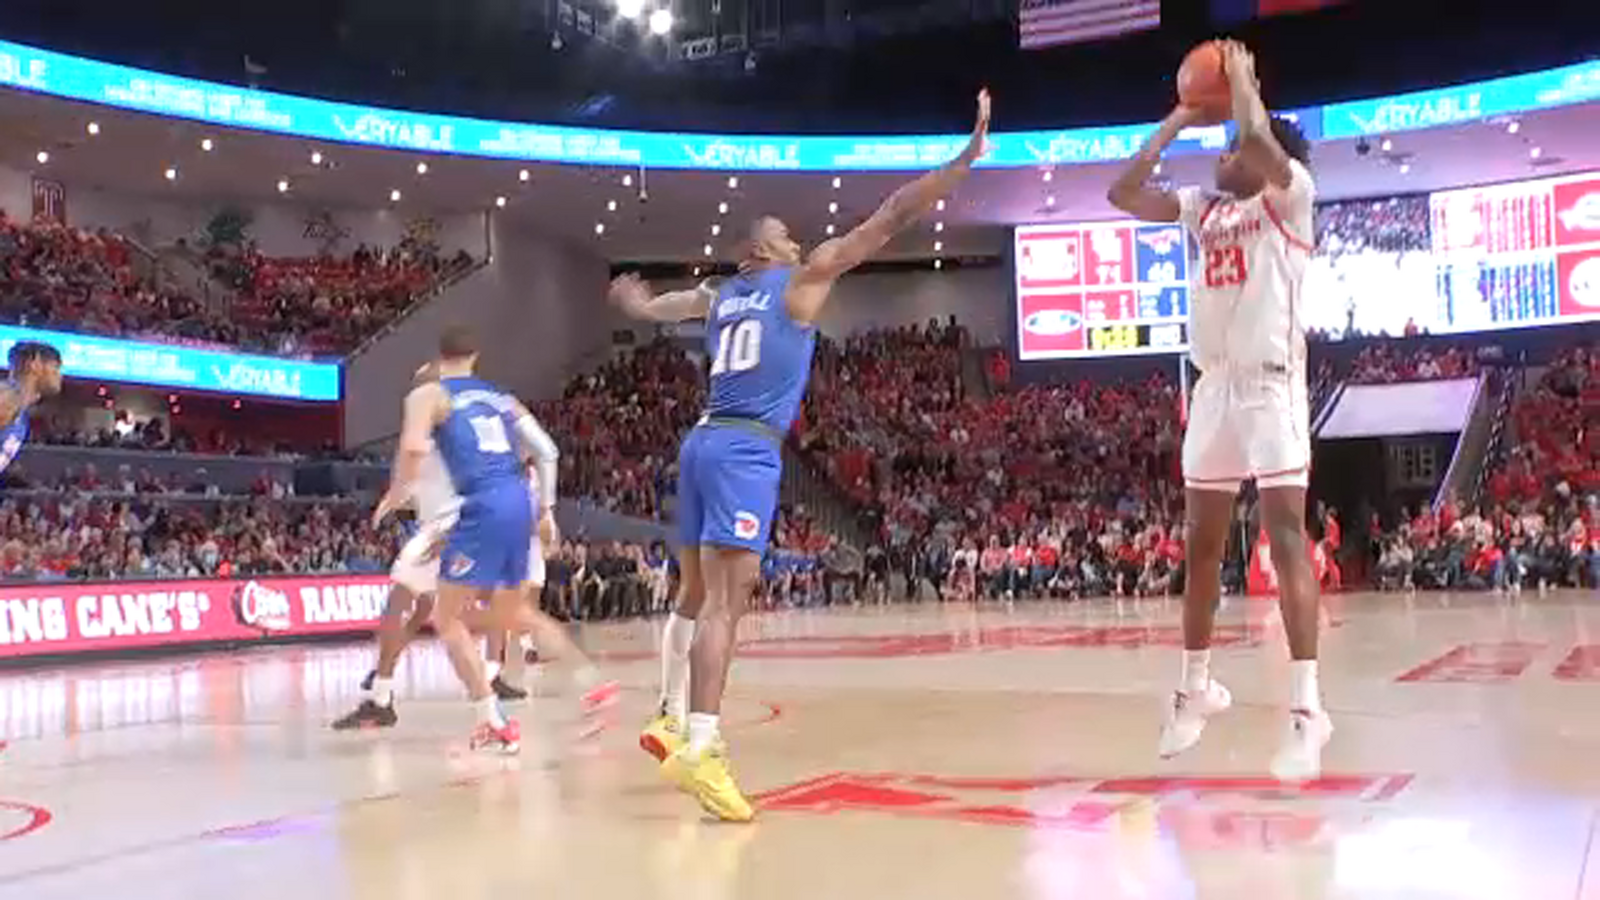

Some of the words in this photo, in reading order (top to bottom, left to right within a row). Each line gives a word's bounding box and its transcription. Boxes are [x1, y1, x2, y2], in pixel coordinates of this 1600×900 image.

[332, 112, 455, 151] VERYABLE
[1350, 93, 1480, 133] VERYABLE
[684, 140, 799, 168] VERYABLE
[1205, 245, 1246, 287] 23
[711, 320, 761, 375] 10
[76, 591, 201, 638] CANE'S
